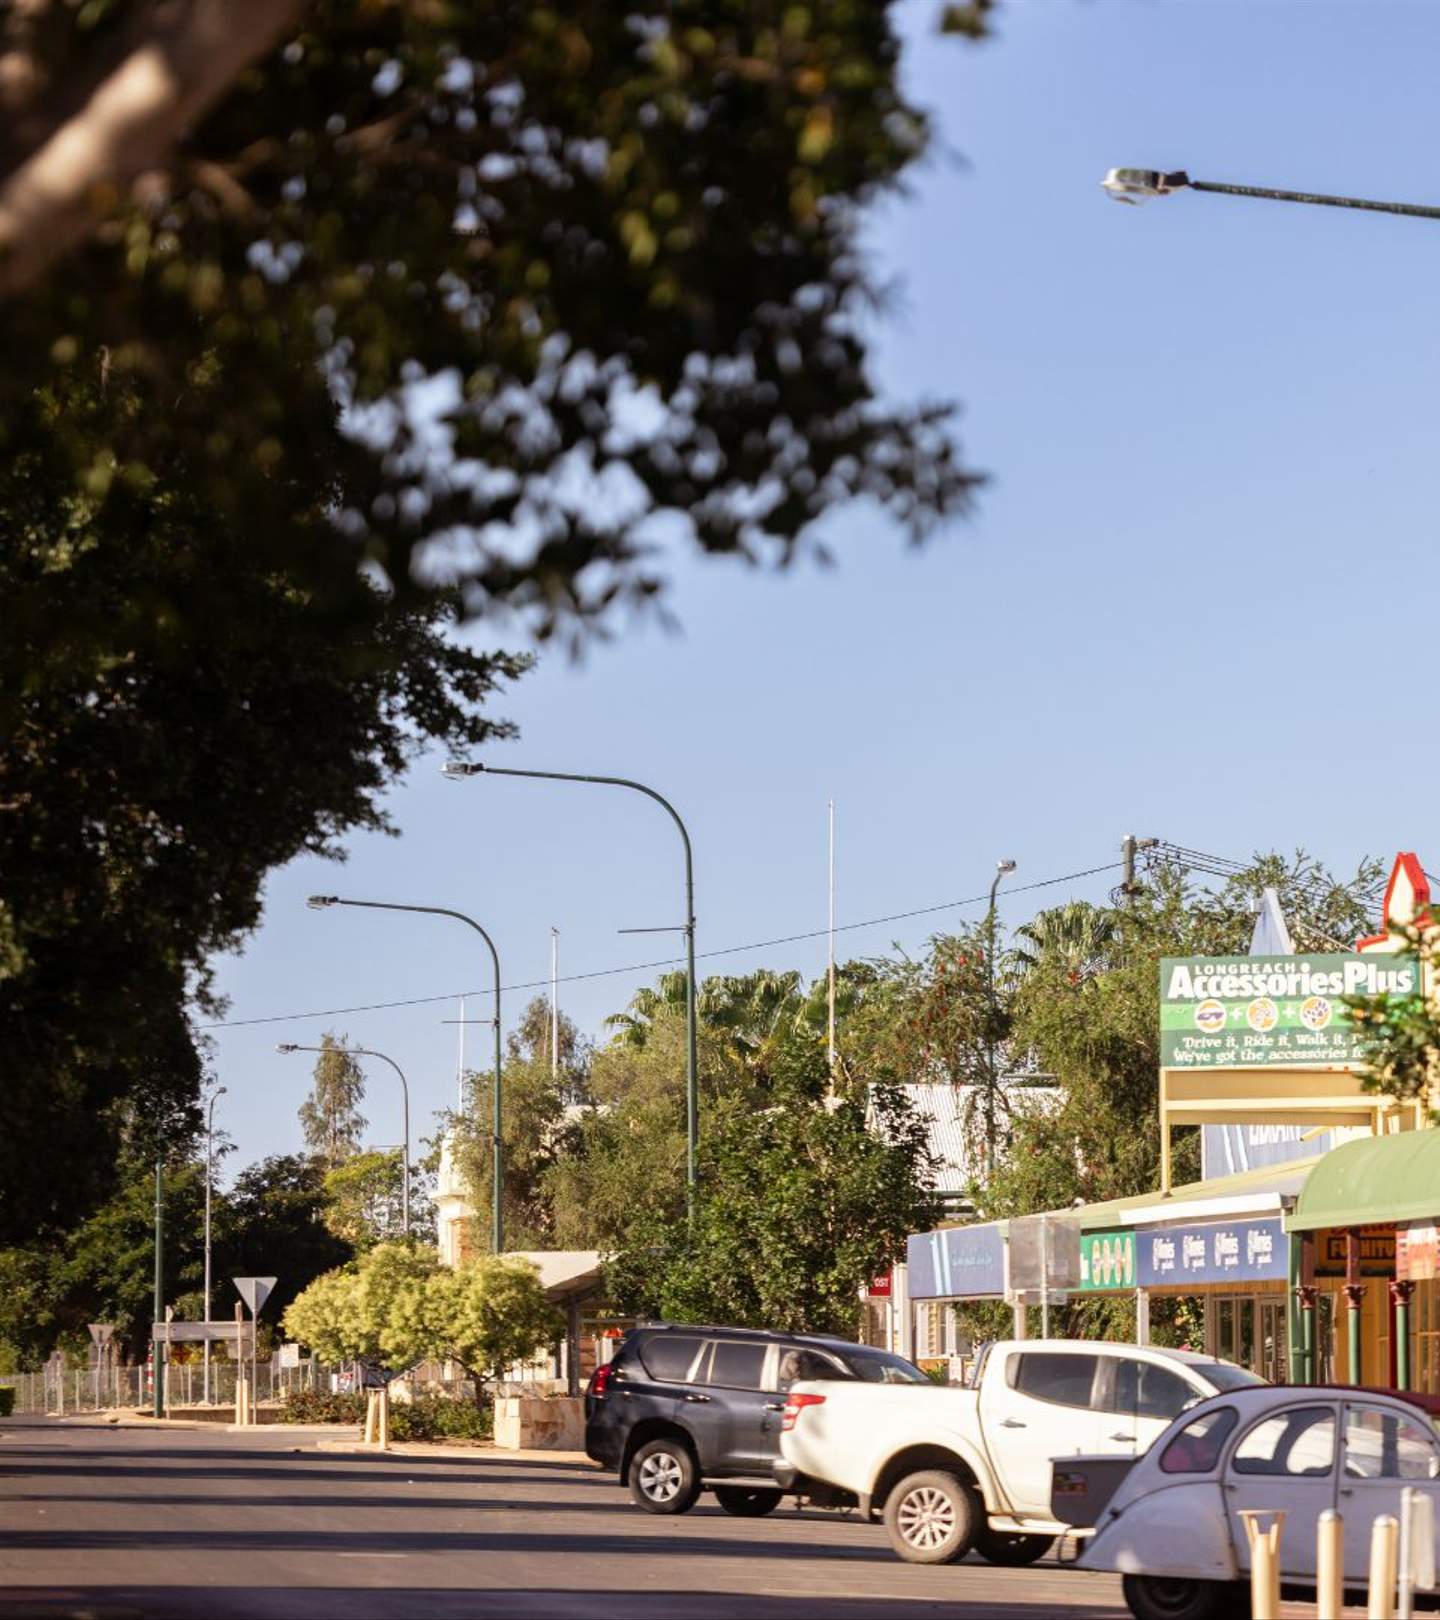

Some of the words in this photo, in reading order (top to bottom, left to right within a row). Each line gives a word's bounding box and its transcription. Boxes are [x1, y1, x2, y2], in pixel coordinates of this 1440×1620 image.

[1195, 963, 1296, 975] LONGREACH
[1244, 1034, 1275, 1047] Ride
[1296, 1031, 1328, 1046] Walk
[1173, 1048, 1211, 1063] We've
[1216, 1050, 1236, 1064] got
[1241, 1047, 1264, 1061] the
[1268, 1047, 1347, 1061] accessories
